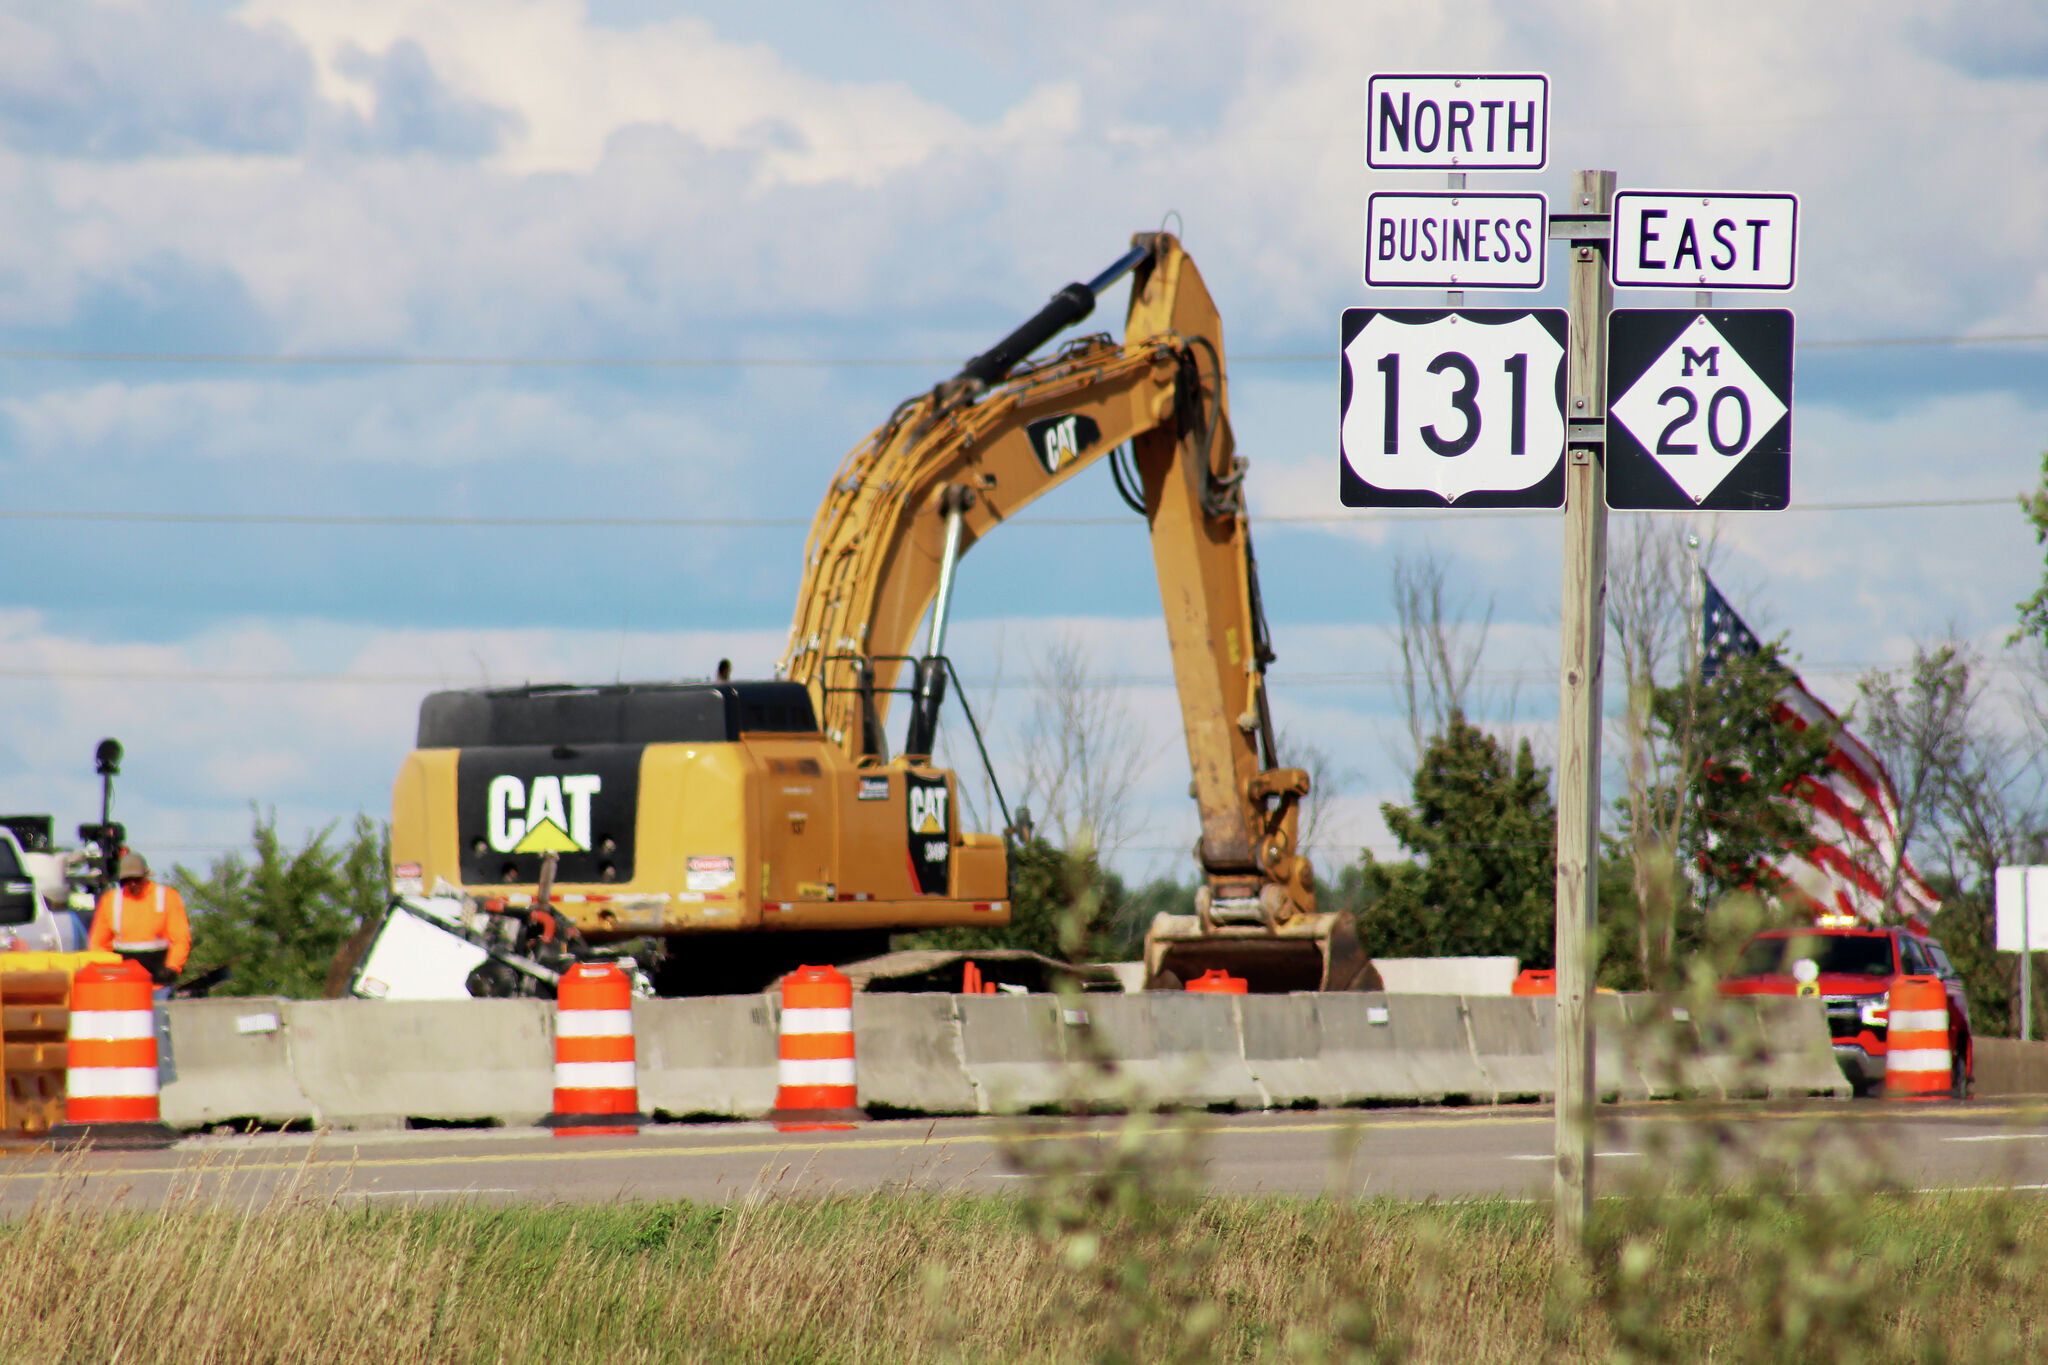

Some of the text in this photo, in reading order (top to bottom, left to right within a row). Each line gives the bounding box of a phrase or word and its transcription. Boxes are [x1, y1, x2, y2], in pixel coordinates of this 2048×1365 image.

[1379, 91, 1535, 153] NORTH
[1378, 217, 1532, 263] BUSINESS
[1638, 209, 1771, 271] EAST
[1681, 346, 1720, 376] M
[1377, 351, 1527, 457] 131
[1656, 385, 1752, 457] 20
[1045, 416, 1078, 471] CAT
[489, 775, 601, 852] CAT
[911, 786, 948, 833] CAT
